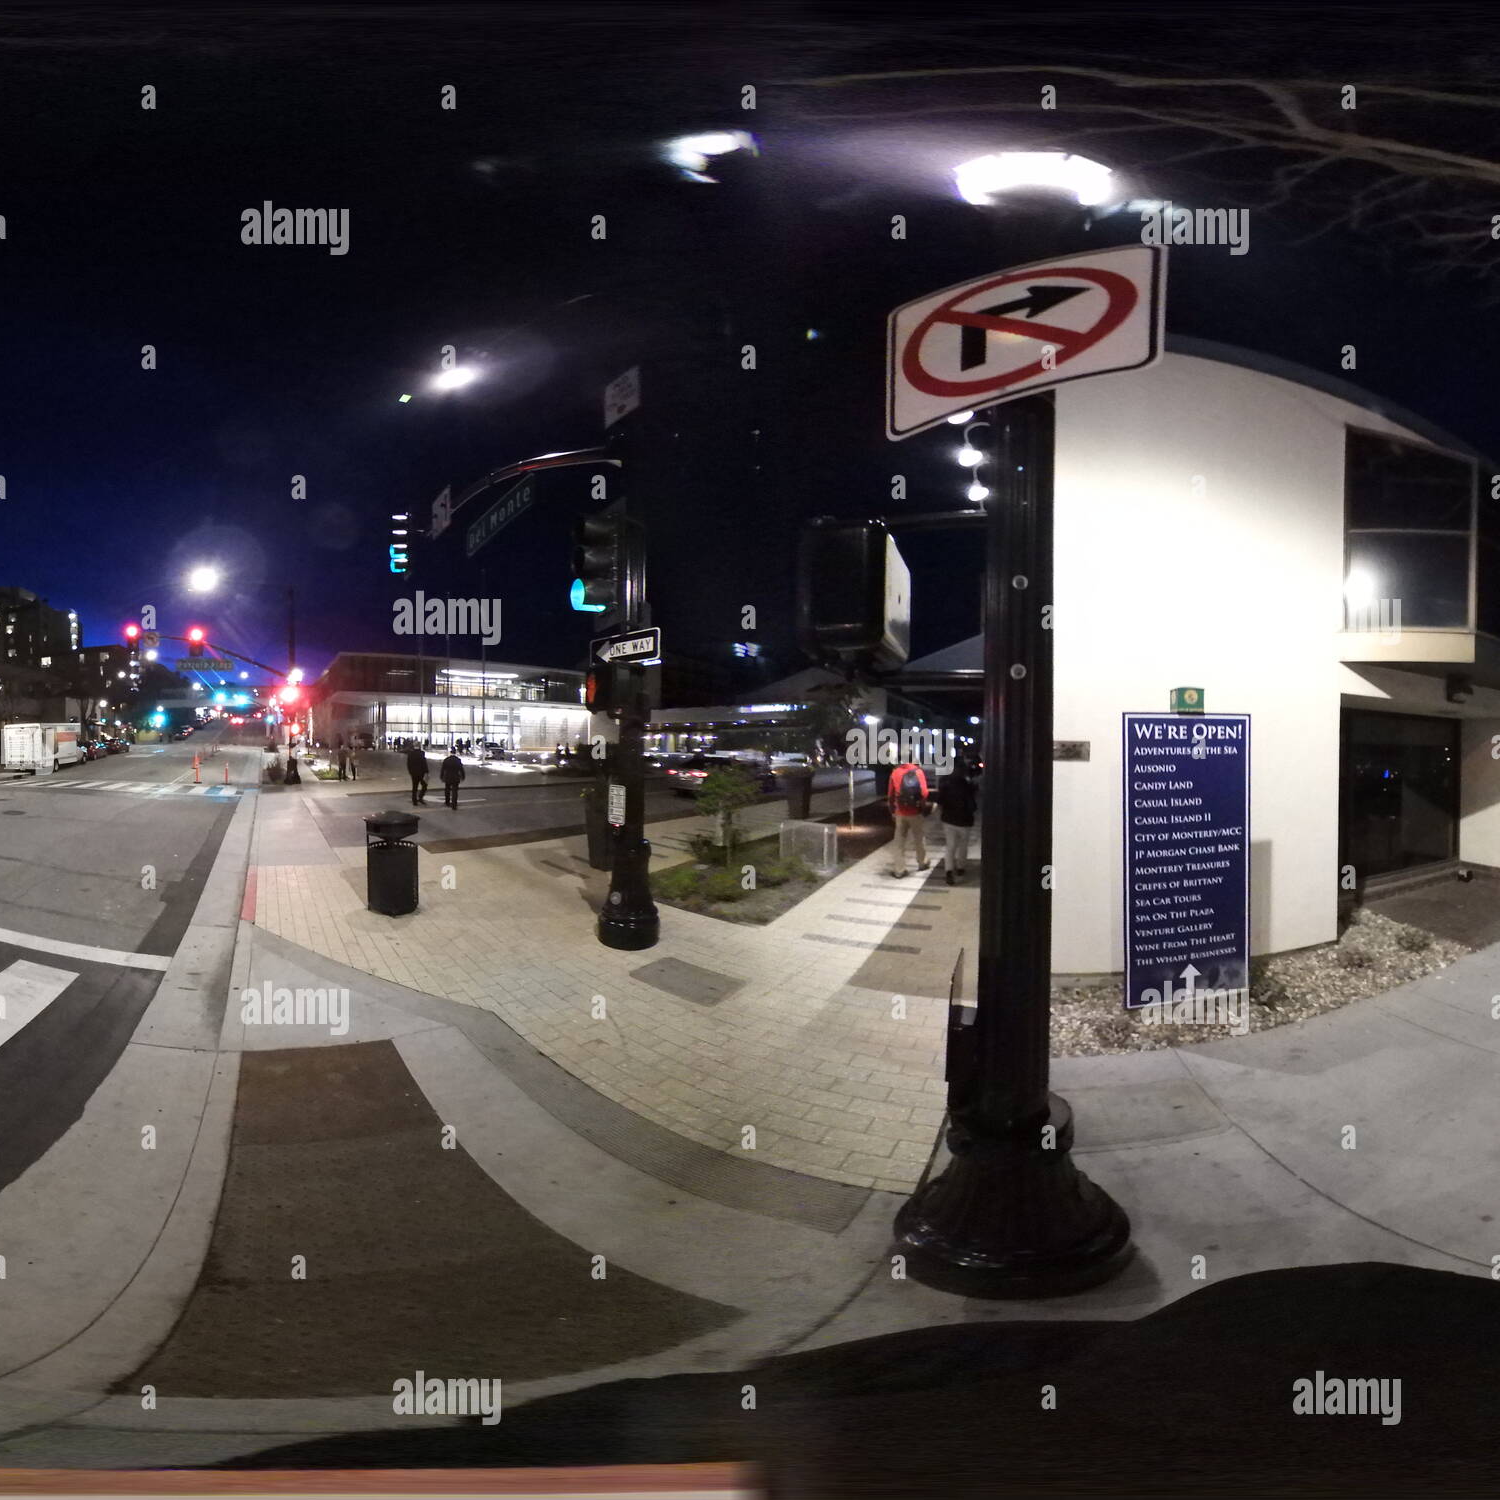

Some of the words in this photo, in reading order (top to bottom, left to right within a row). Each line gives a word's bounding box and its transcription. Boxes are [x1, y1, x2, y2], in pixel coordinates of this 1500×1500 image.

[469, 521, 486, 549] Del
[489, 486, 531, 528] Monte
[609, 643, 627, 657] ONE
[632, 639, 652, 652] WAY
[1134, 722, 1187, 740] WE'RE
[1192, 723, 1242, 740] OPEN!
[1134, 746, 1191, 756] ADVENTURES
[1193, 747, 1202, 755] BY
[1205, 746, 1221, 755] THE
[1223, 745, 1238, 755] SEA
[1134, 764, 1176, 773] AUSONIO
[1134, 781, 1167, 791] CANDY
[1169, 780, 1193, 789] LAND
[1134, 799, 1168, 808] CASUAL
[1171, 797, 1202, 807] ISLAND
[1134, 816, 1168, 826] CASUAL
[1171, 814, 1202, 824] ISLAND
[1204, 812, 1211, 822] II
[1135, 833, 1157, 842] CITY
[1157, 832, 1170, 841] OF
[1172, 826, 1242, 840] MONTEREY/MCC
[1135, 850, 1145, 860] JP
[1146, 848, 1186, 858] MORGAN
[1188, 846, 1216, 855] CHASE
[1218, 843, 1240, 852] BANK
[1135, 864, 1184, 875] MONTEREY
[1185, 859, 1230, 871] TREASURES
[1135, 881, 1167, 891] CREPES
[1169, 881, 1180, 889] OF
[1183, 876, 1223, 887] BRITTANY
[1135, 899, 1151, 907] SEA
[1152, 897, 1171, 906] CAR
[1173, 894, 1202, 904] TOURS
[1135, 914, 1151, 922] SPA
[1152, 913, 1167, 921] ON
[1169, 911, 1187, 919] THE
[1190, 907, 1214, 917] PLAZA
[1135, 926, 1175, 937] VENTURE
[1177, 922, 1214, 933] GALLERY
[1135, 943, 1160, 952] WINE
[1163, 940, 1187, 950] FROM
[1190, 938, 1208, 946] THE
[1209, 932, 1235, 943] HEART
[1136, 958, 1153, 966] THE
[1156, 954, 1188, 964] WHARF
[1190, 946, 1237, 959] BUSINESSES
